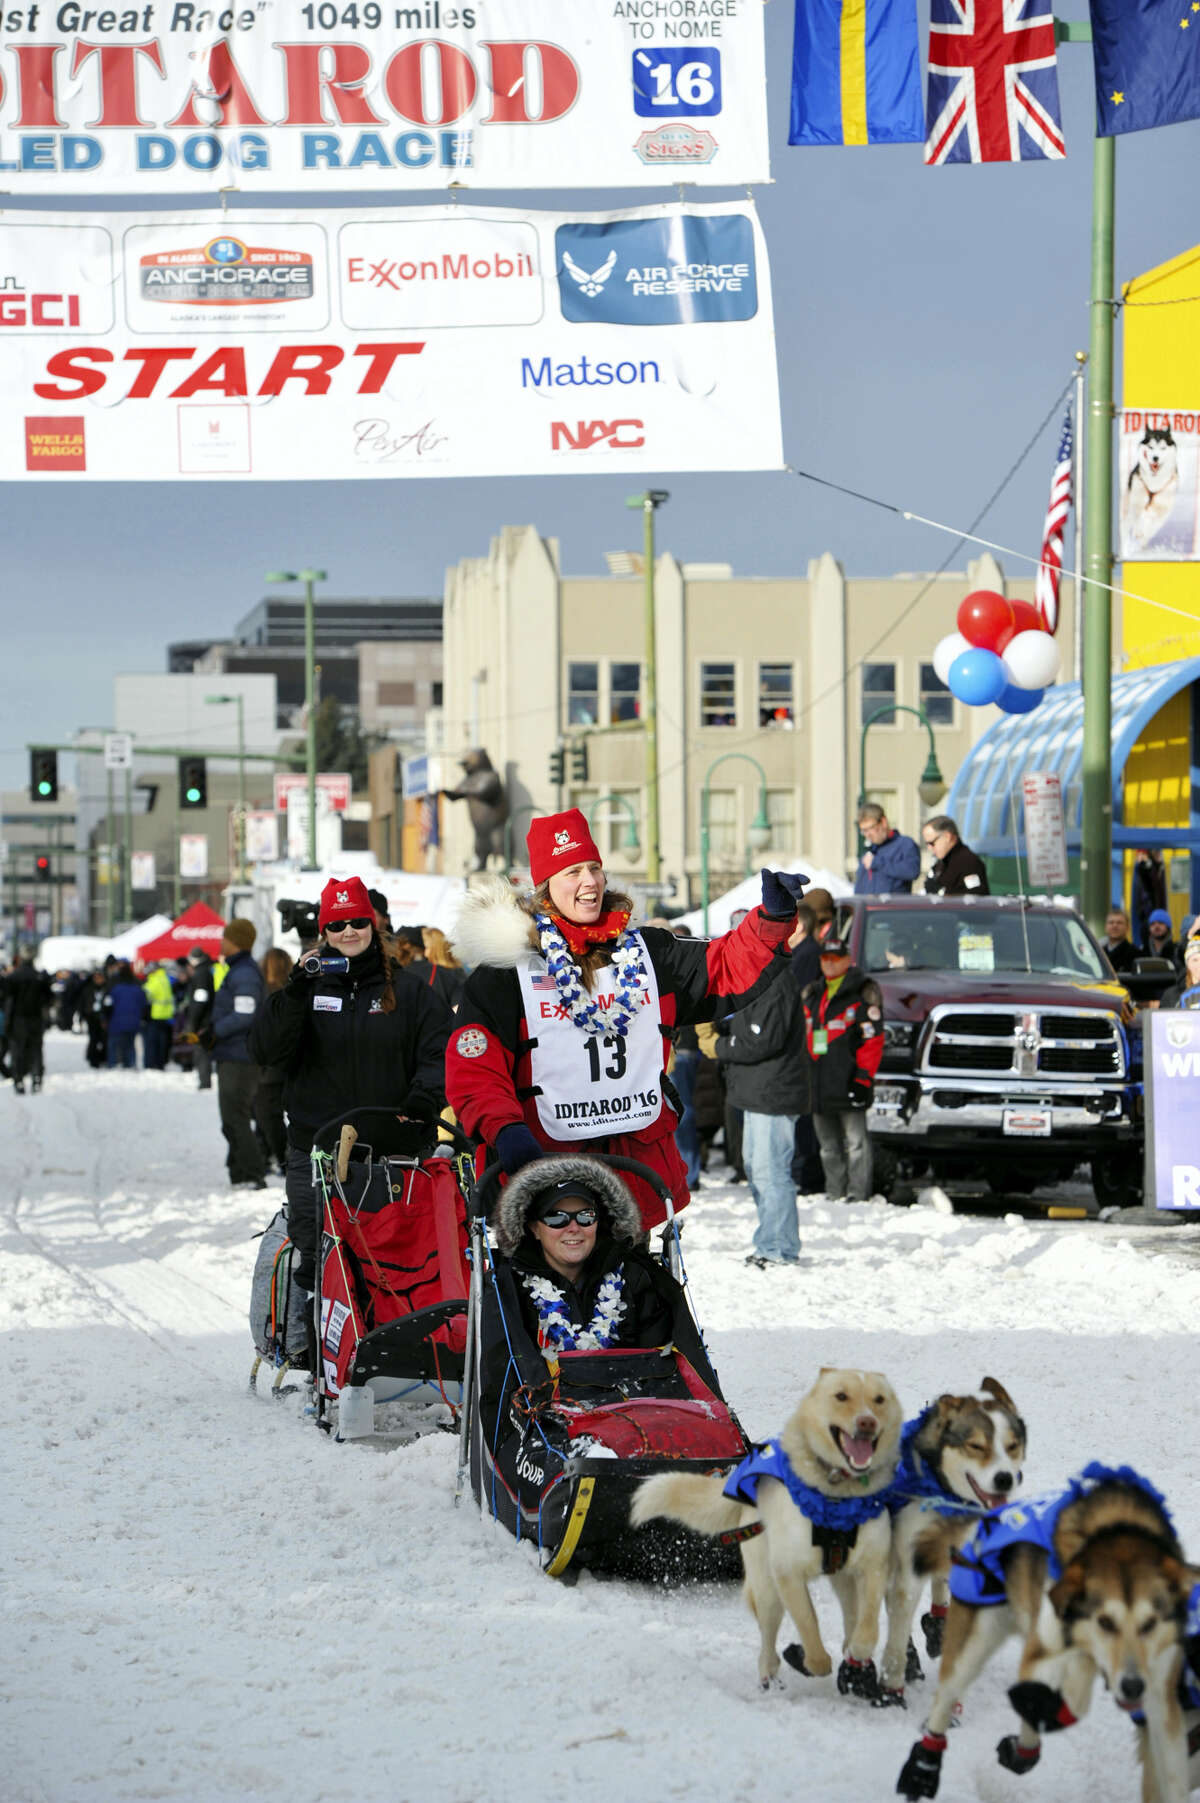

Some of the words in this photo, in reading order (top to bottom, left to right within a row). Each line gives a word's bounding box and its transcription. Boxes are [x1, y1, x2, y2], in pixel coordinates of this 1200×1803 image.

[0, 5, 39, 33] st
[56, 2, 154, 33] Great
[301, 3, 382, 30] 1049
[395, 1, 476, 29] miles
[614, 0, 736, 17] ANCHORAGE
[629, 22, 654, 39] TO
[665, 21, 722, 38] NOME
[0, 37, 581, 128] ITAROD
[136, 132, 269, 171] DOG
[301, 129, 474, 170] RACE
[146, 267, 308, 284] ANCHORAGE
[348, 253, 533, 290] ExxonMobil
[625, 266, 668, 282] AIR
[671, 263, 750, 280] FORCE
[632, 278, 742, 296] RESERVE
[0, 294, 80, 327] GCI
[33, 342, 426, 400] START
[521, 355, 660, 388] Matson
[551, 419, 645, 450] NAC
[1124, 412, 1200, 434] IDITARO
[30, 435, 84, 446] WELLS
[32, 446, 83, 457] FARGO
[584, 1035, 627, 1082] 13
[555, 1096, 631, 1119] IDITAROD
[634, 1089, 658, 1108] '16
[568, 1110, 652, 1128] www.iditarod.com
